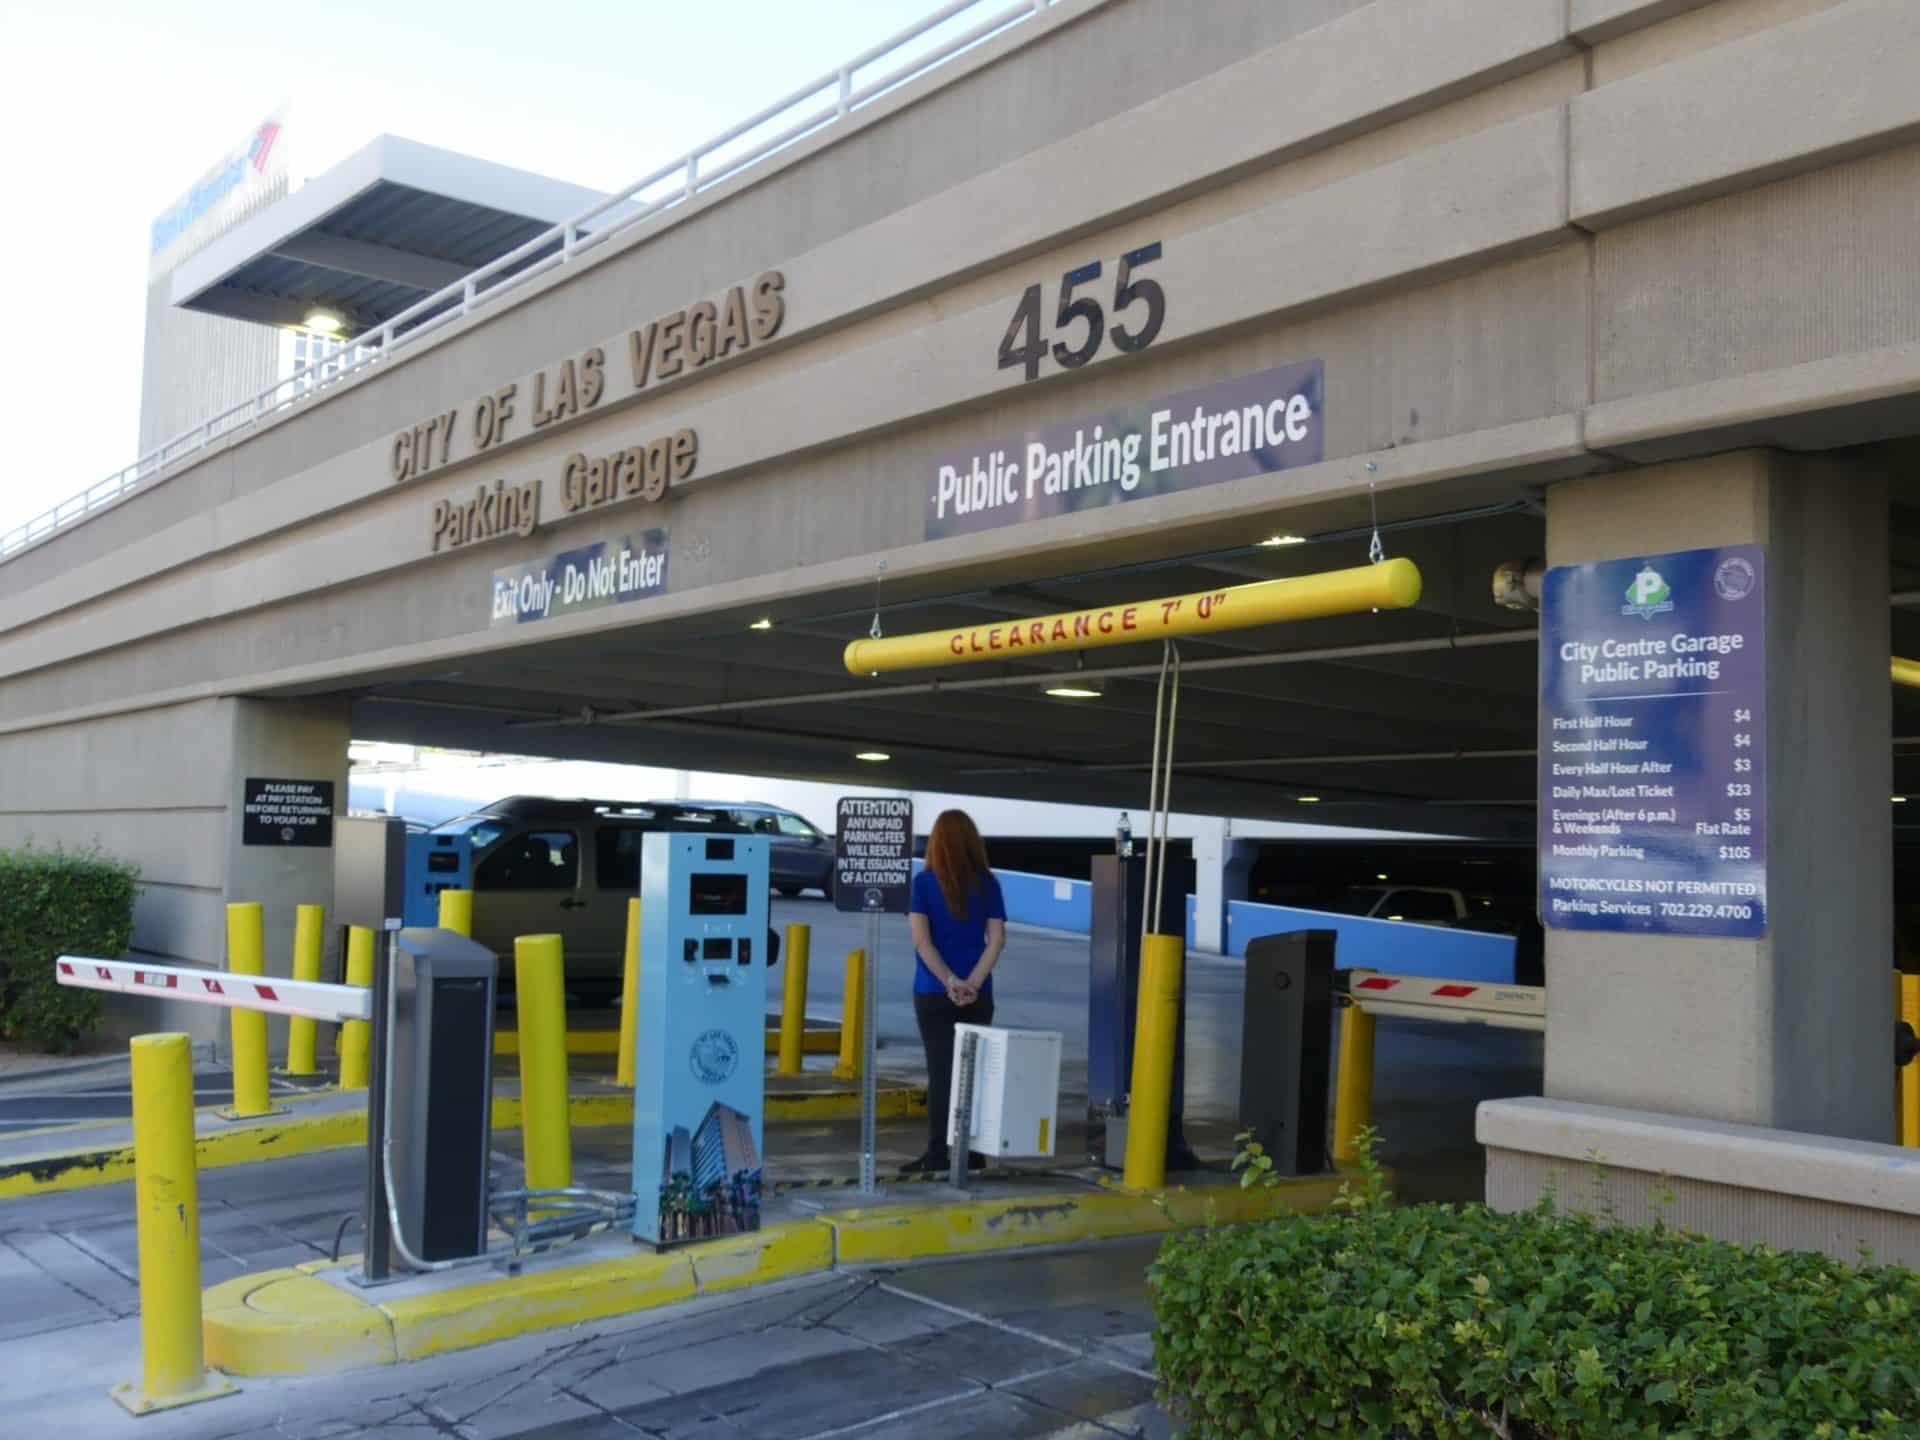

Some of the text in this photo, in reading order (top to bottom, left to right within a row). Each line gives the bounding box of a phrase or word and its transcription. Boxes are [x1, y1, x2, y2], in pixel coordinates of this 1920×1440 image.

[997, 241, 1166, 381] 455
[391, 271, 785, 482] CITY OF LAS VEGAS
[937, 393, 1310, 518] Public Parking Entrance
[432, 427, 697, 551] Parking Garage
[493, 577, 519, 618] Exit
[521, 573, 554, 617] Only
[565, 564, 586, 604] Do
[588, 557, 617, 596] Not
[620, 550, 664, 592] Enter
[951, 606, 1138, 656] CLEARANCE
[1560, 633, 1743, 662] City Centre Garage
[1581, 657, 1720, 683] Public Parking
[1553, 716, 1633, 729] First Half Hour
[1734, 709, 1750, 722] $4
[1553, 738, 1648, 752] Second Half Hour
[1734, 734, 1750, 747] $4
[1553, 761, 1672, 777] Every Half Hour After
[1734, 758, 1750, 772] $3
[265, 784, 296, 793] PLEASE
[1553, 784, 1674, 800] Daily Max/Lost Ticket
[1727, 783, 1751, 797] $23
[839, 800, 910, 816] ATTENTION
[1734, 808, 1750, 822] $5
[260, 816, 317, 824] TO YOUR CAR
[1553, 809, 1600, 823] Evenings
[1602, 808, 1636, 822] (After
[1638, 809, 1646, 821] 6
[847, 817, 903, 829] ANY UNPAID
[1553, 823, 1621, 835] & Weekends
[1695, 822, 1751, 836] Flat Rate
[843, 831, 905, 843] PARKING FEES
[847, 844, 902, 857] WILL RESULT
[1553, 844, 1644, 859] Monthly Parking
[1719, 846, 1751, 859] $105
[838, 858, 910, 871] IN THE ISSUANCE
[841, 871, 906, 884] OF A CITATION
[1550, 878, 1756, 896] MOTORCYCLES NOT PERMITTED
[1553, 899, 1752, 919] Parking Services 702.229.4700
